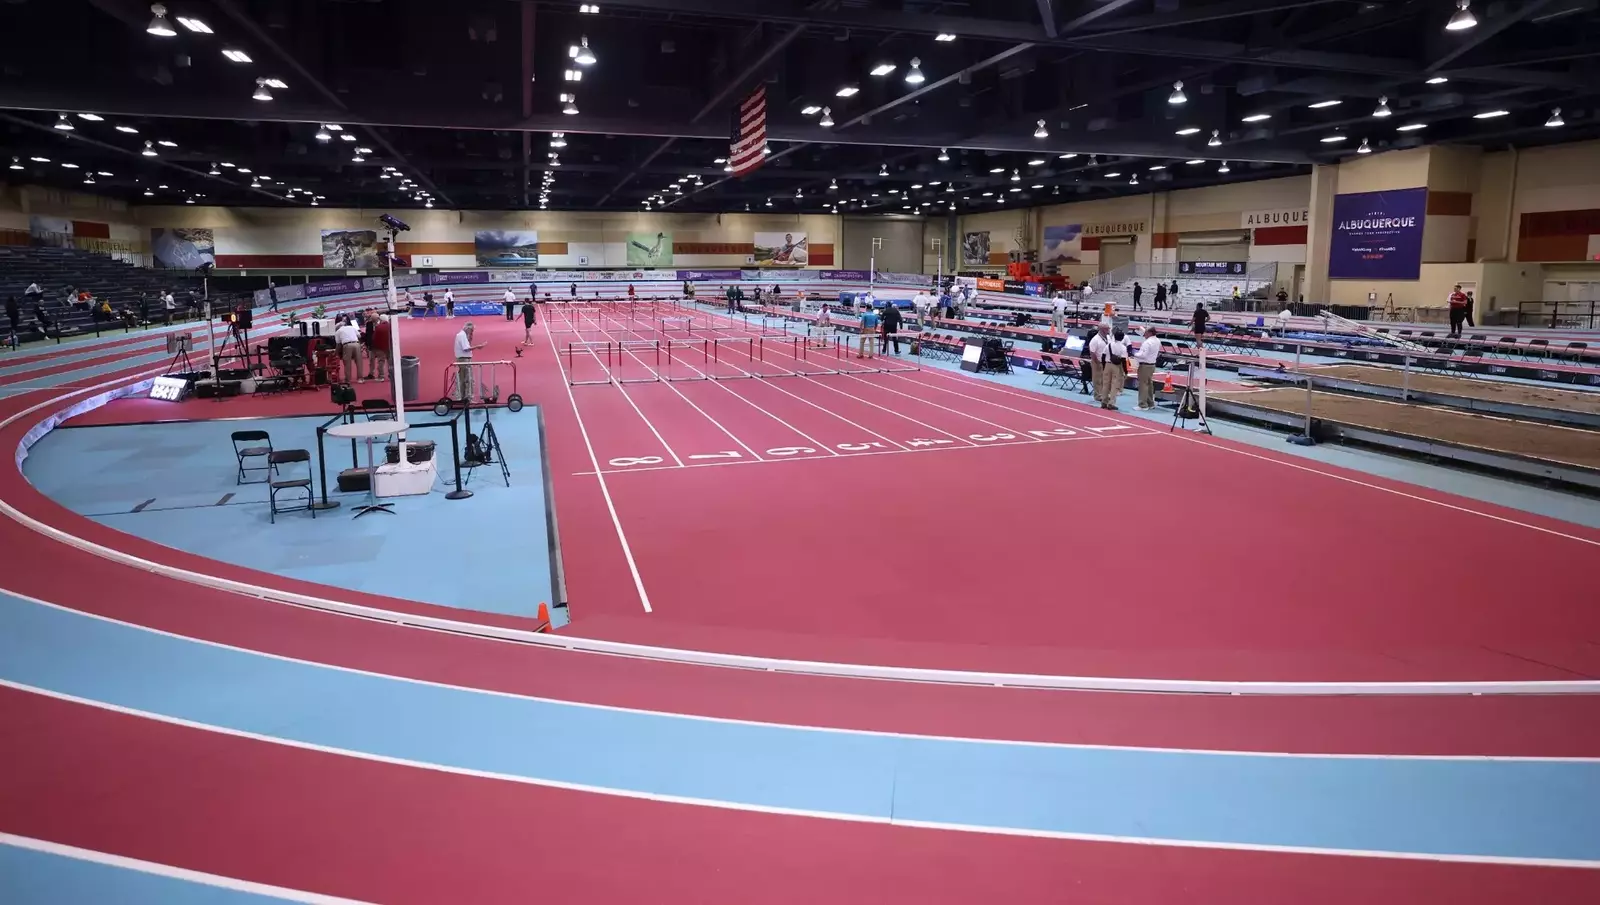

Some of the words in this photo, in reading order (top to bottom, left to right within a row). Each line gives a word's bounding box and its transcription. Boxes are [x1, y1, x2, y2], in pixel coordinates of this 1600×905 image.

[1086, 222, 1144, 234] ALBUQUERQUE
[1338, 217, 1415, 230] ALBUQUERQUE
[1028, 428, 1077, 437] 2
[1083, 424, 1133, 433] 1
[904, 437, 954, 447] 4
[969, 433, 1016, 442] 3
[766, 446, 817, 455] 6
[837, 441, 888, 451] 5
[688, 450, 742, 459] 7
[609, 456, 663, 466] 8
